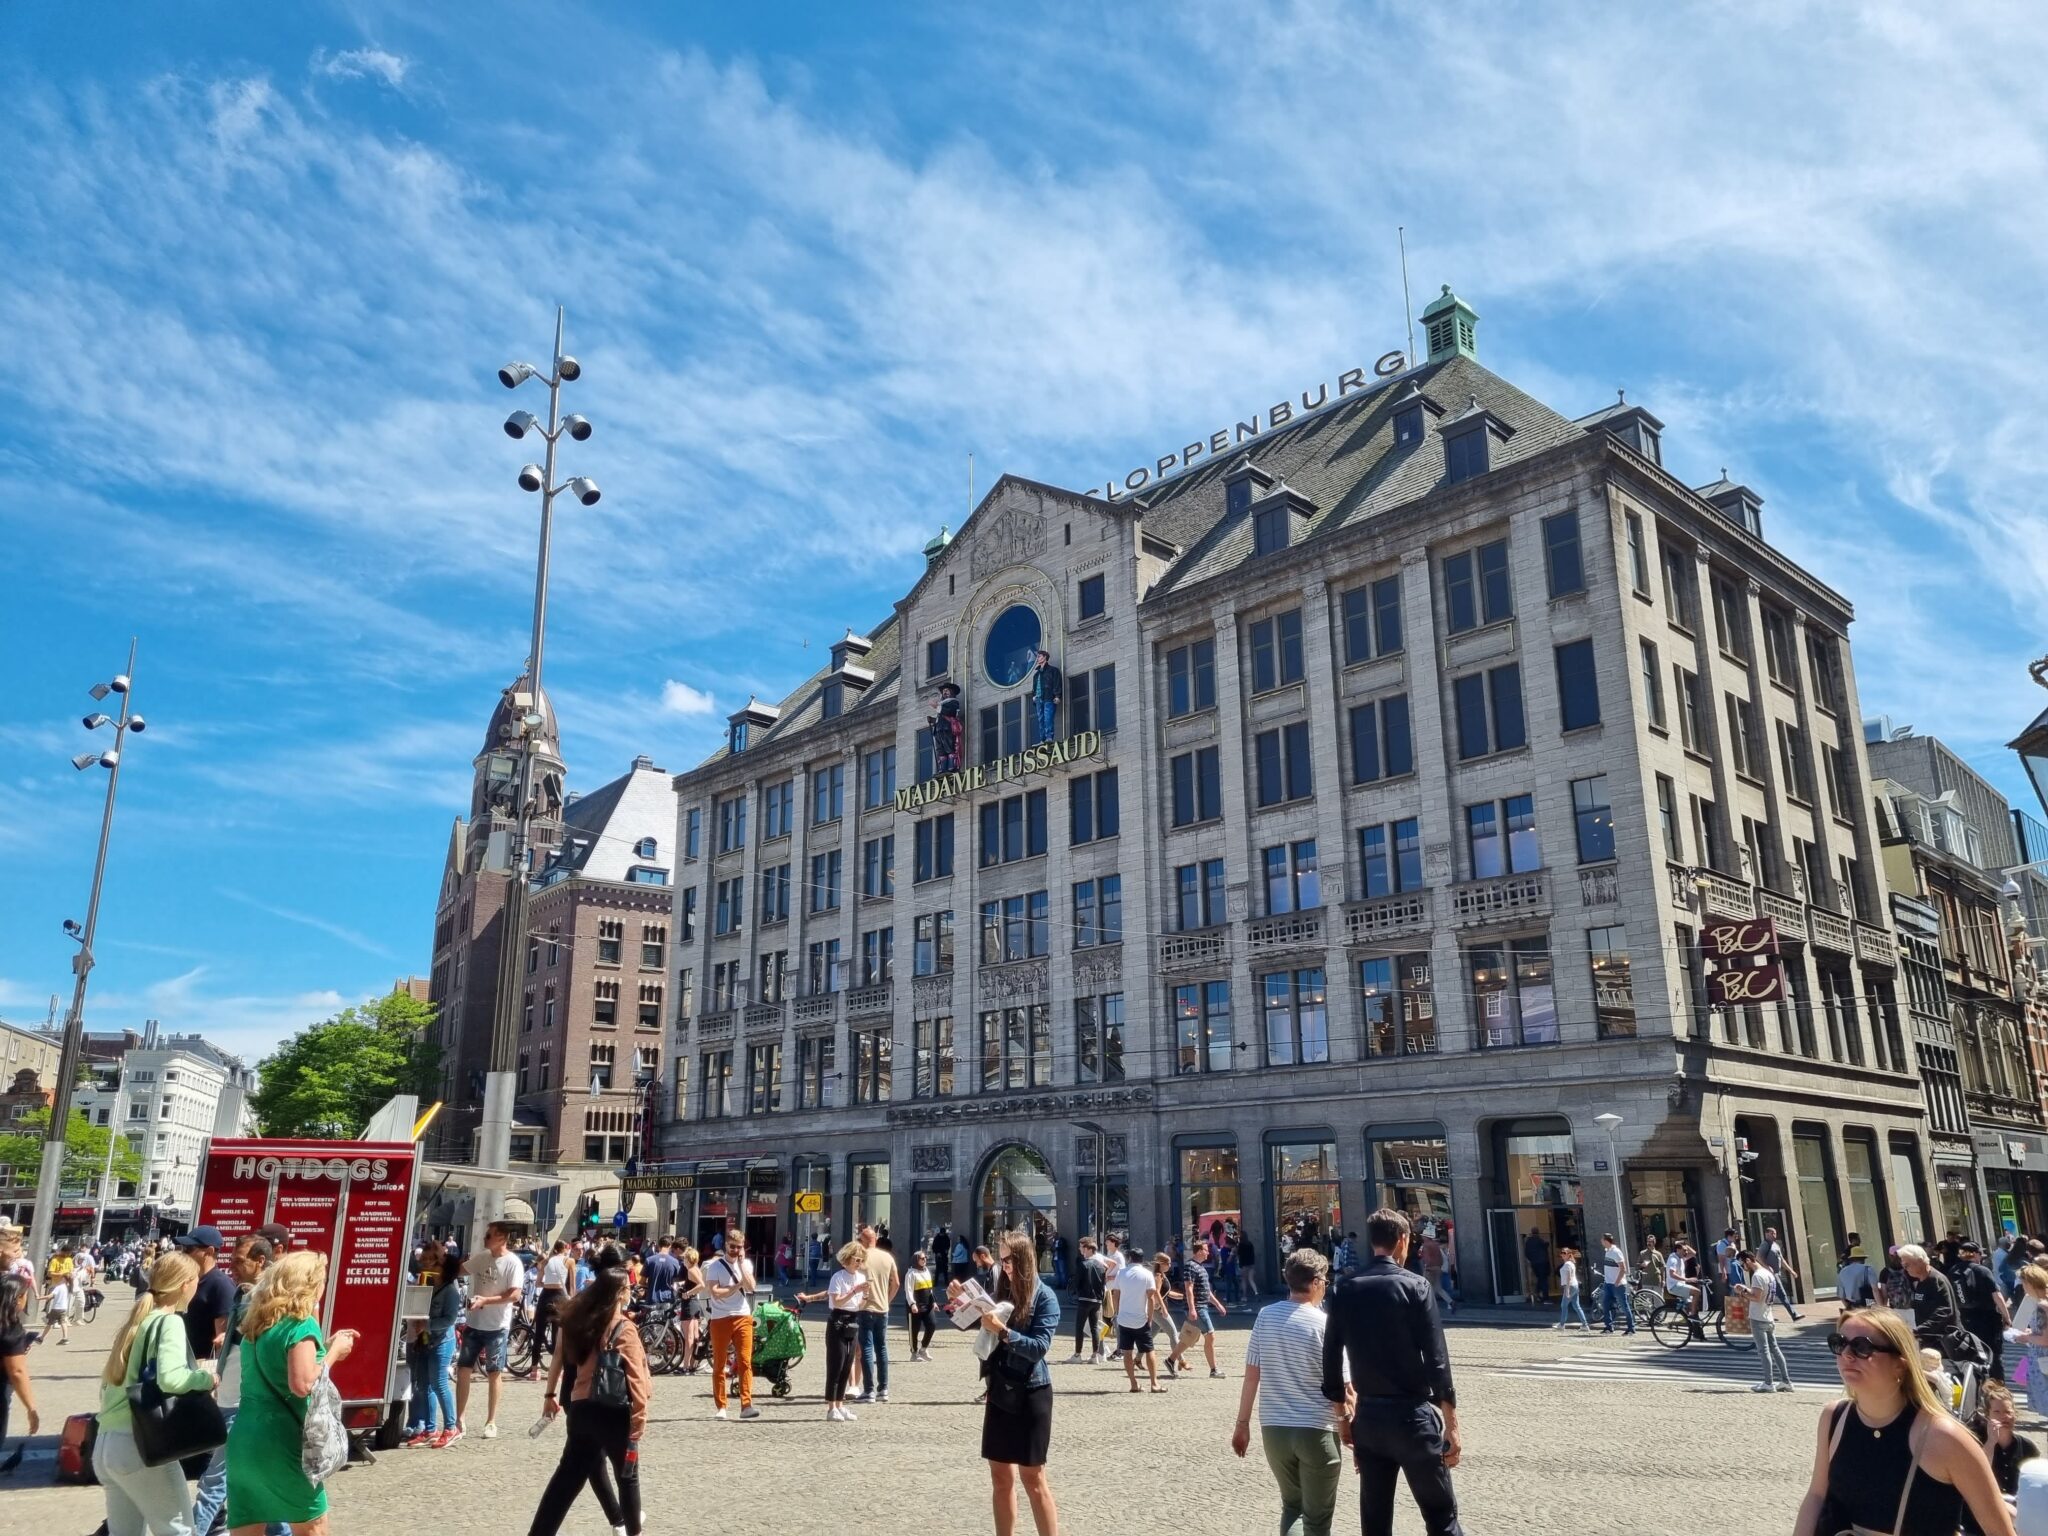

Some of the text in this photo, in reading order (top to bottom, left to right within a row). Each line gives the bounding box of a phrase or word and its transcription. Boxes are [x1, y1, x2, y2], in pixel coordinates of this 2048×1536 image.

[894, 764, 988, 814] MADAME
[1710, 924, 1771, 955] P&C
[1717, 970, 1778, 1001] P&C
[232, 1156, 388, 1181] HOTDOGS
[625, 1176, 695, 1190] MADAME TUSSAUD
[345, 1276, 389, 1285] DRINKS
[346, 1267, 391, 1276] ICE COLD
